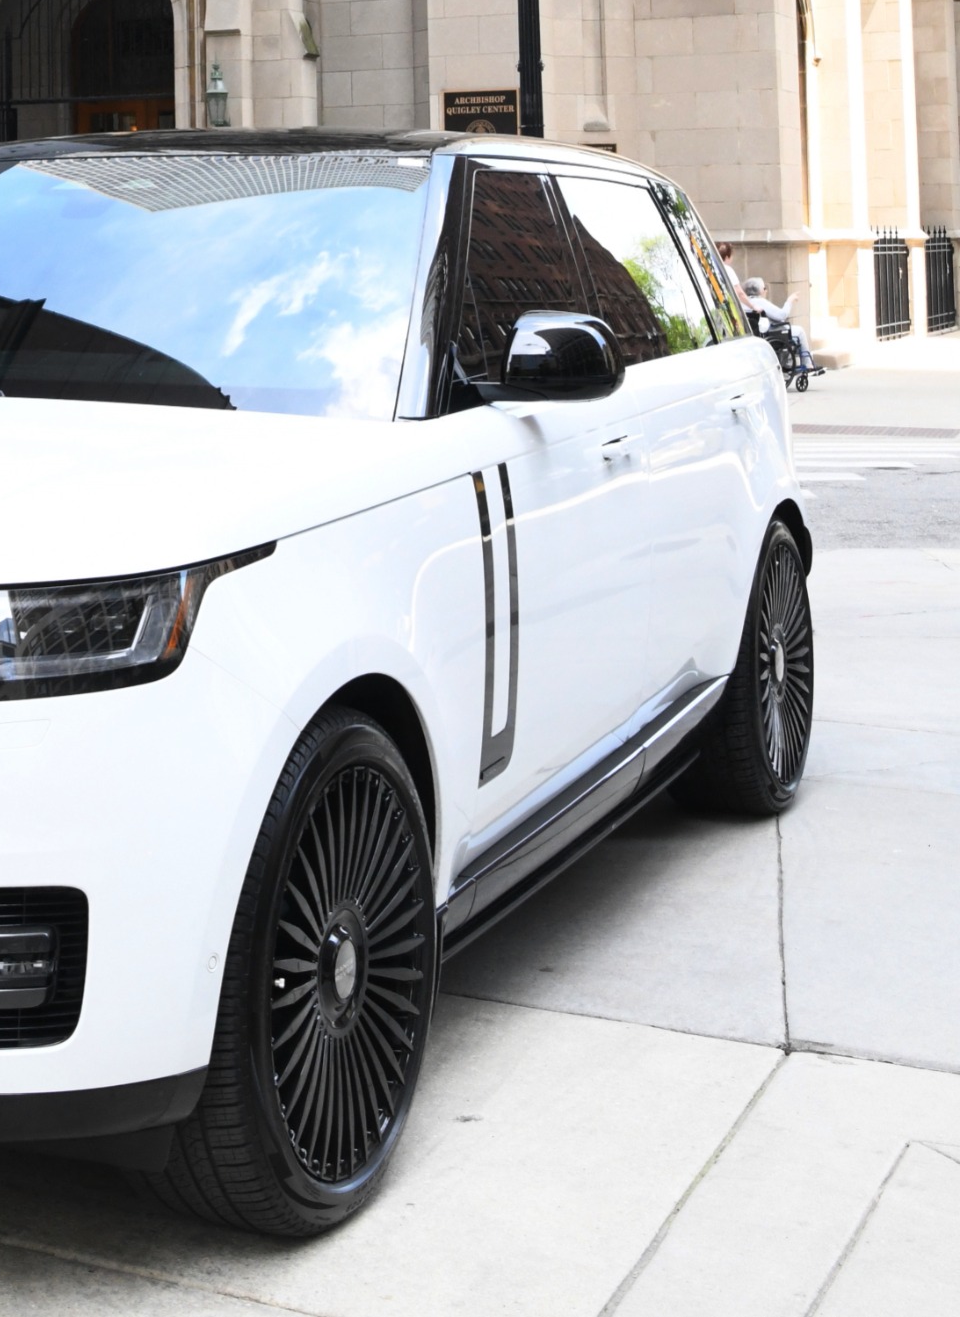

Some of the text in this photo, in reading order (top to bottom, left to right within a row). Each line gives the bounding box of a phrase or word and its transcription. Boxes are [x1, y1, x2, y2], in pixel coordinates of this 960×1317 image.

[454, 95, 506, 104] ARCHBISHOP
[446, 105, 515, 115] QUIGLEY CENTER
